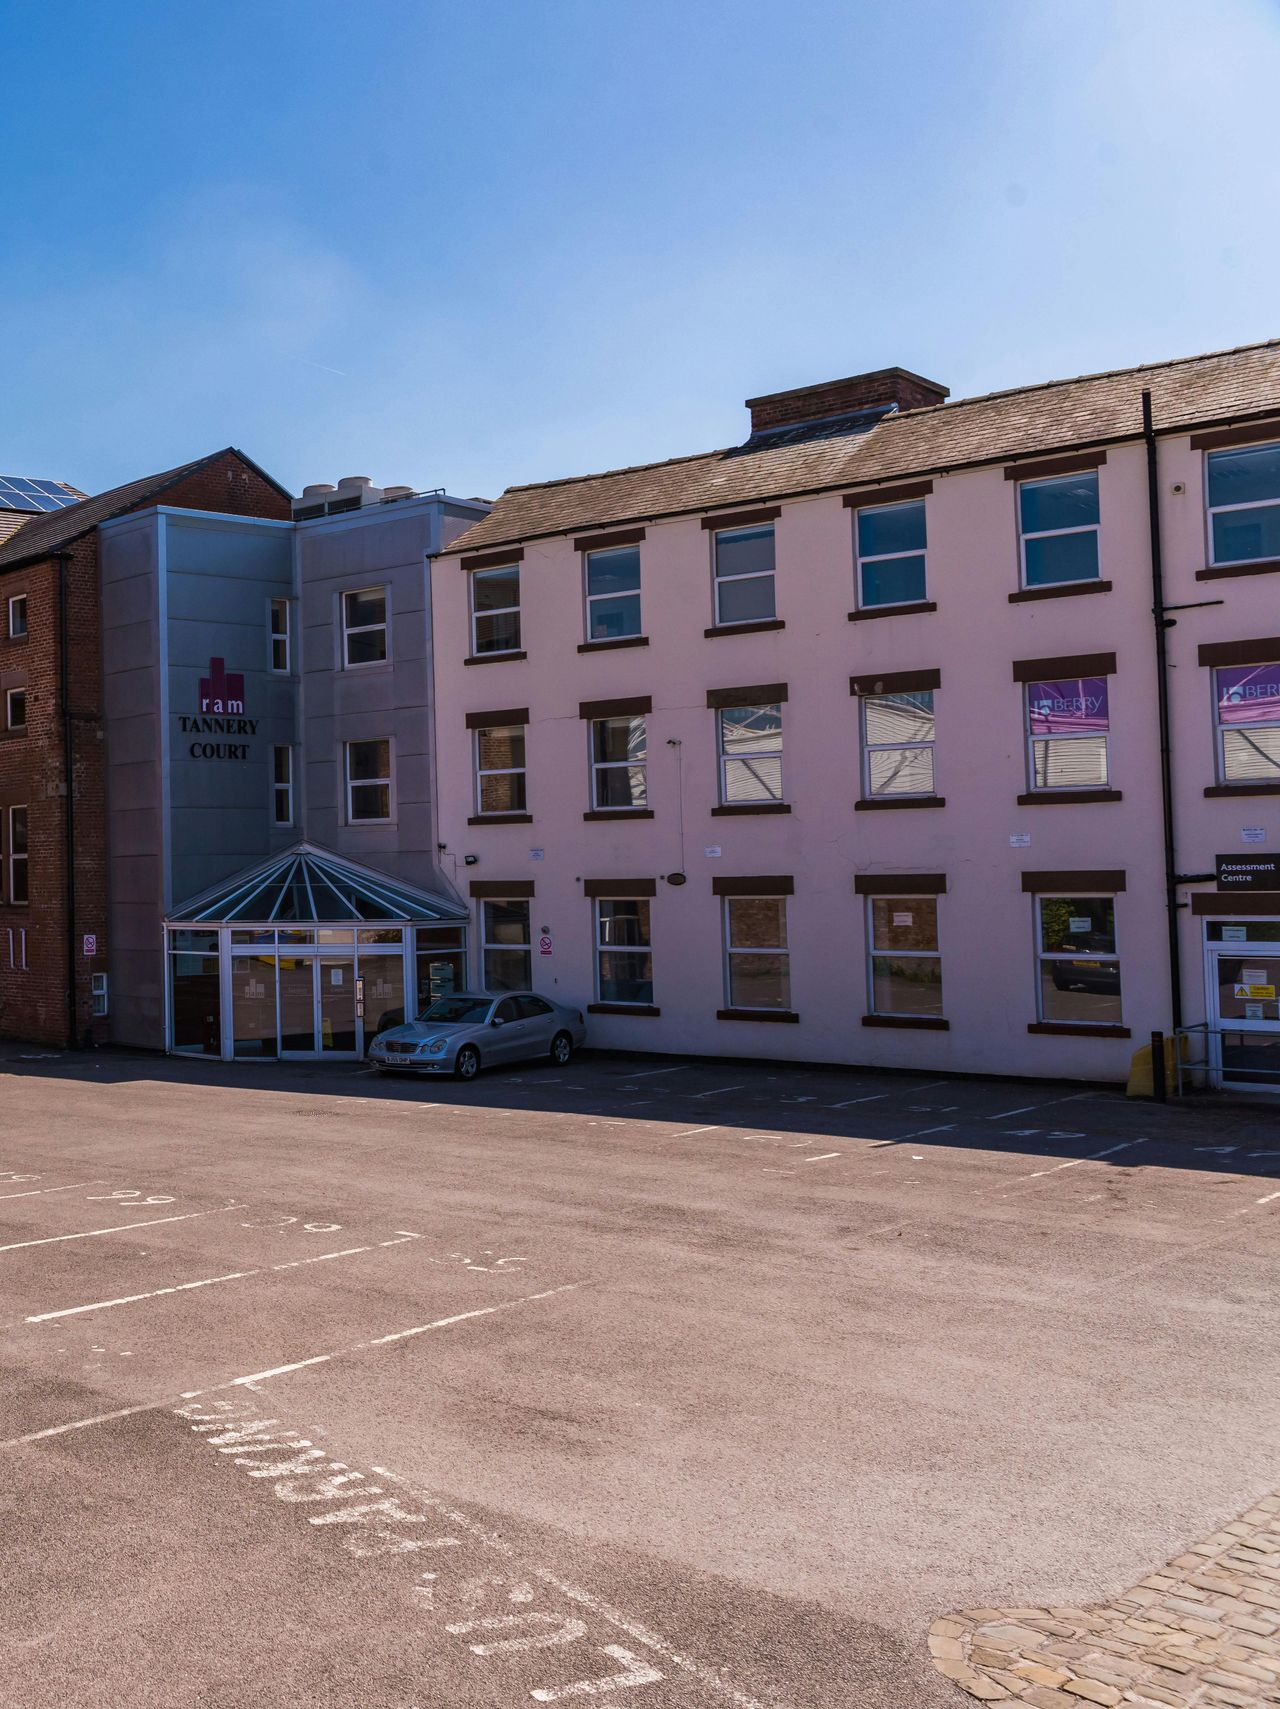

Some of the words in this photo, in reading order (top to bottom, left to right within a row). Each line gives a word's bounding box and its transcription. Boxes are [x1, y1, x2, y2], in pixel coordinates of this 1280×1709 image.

[1245, 683, 1280, 698] BER
[202, 697, 243, 714] ram
[1054, 696, 1103, 714] BERRY
[178, 716, 260, 735] TANNERY
[189, 742, 250, 760] COURT
[1220, 862, 1276, 872] Assessment
[1221, 873, 1253, 883] Centre
